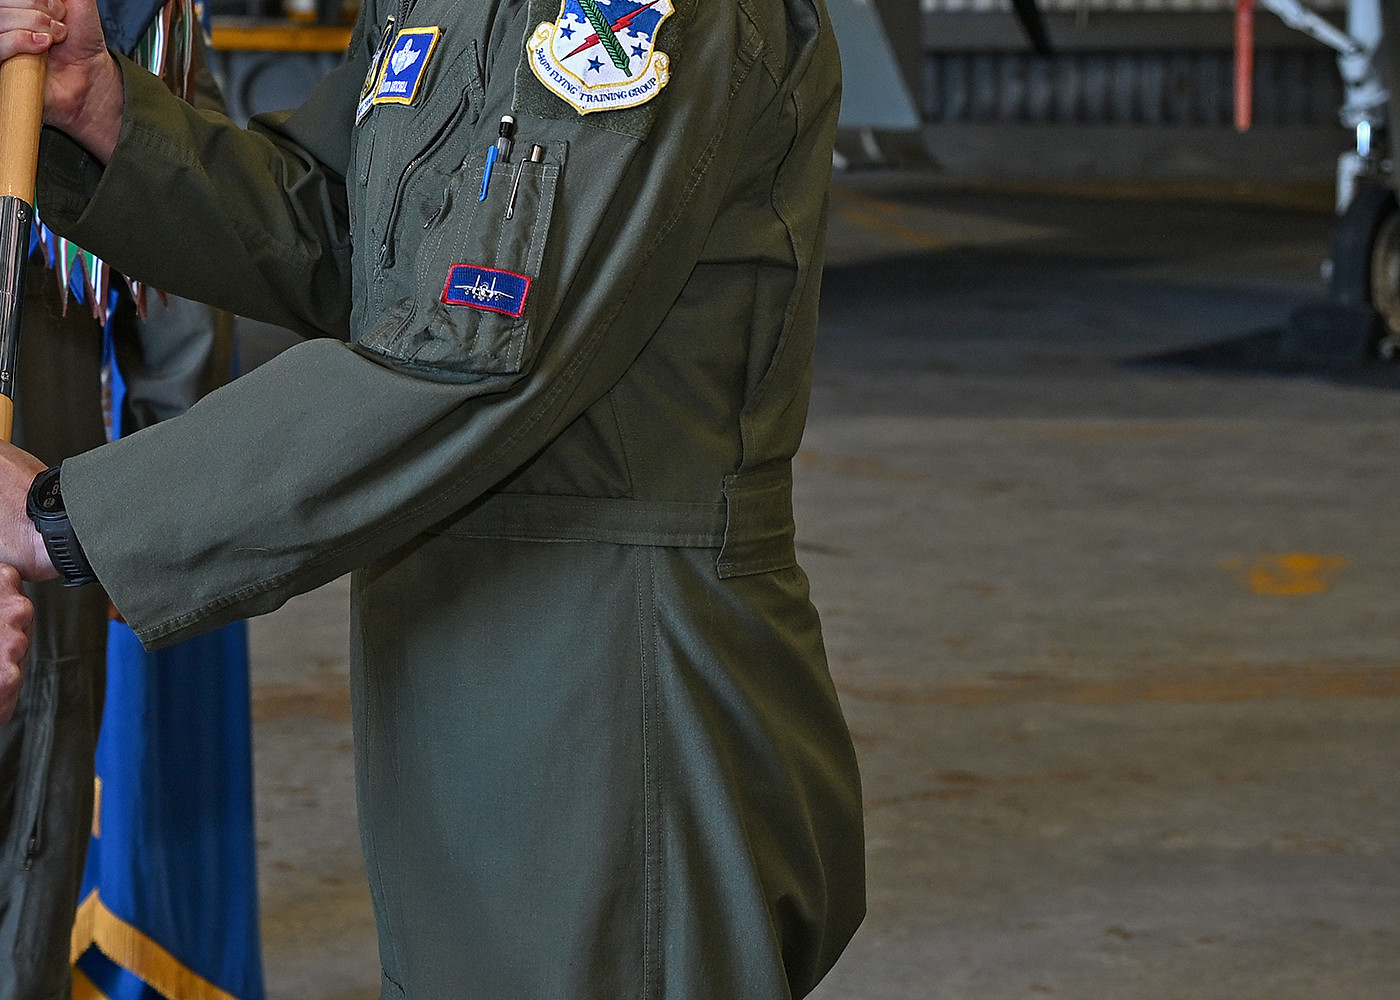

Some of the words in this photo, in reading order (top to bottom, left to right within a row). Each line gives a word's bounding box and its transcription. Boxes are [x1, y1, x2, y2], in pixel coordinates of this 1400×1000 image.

[550, 71, 578, 95] FLYING
[579, 91, 627, 103] TRAINING
[628, 77, 657, 98] GROUP
